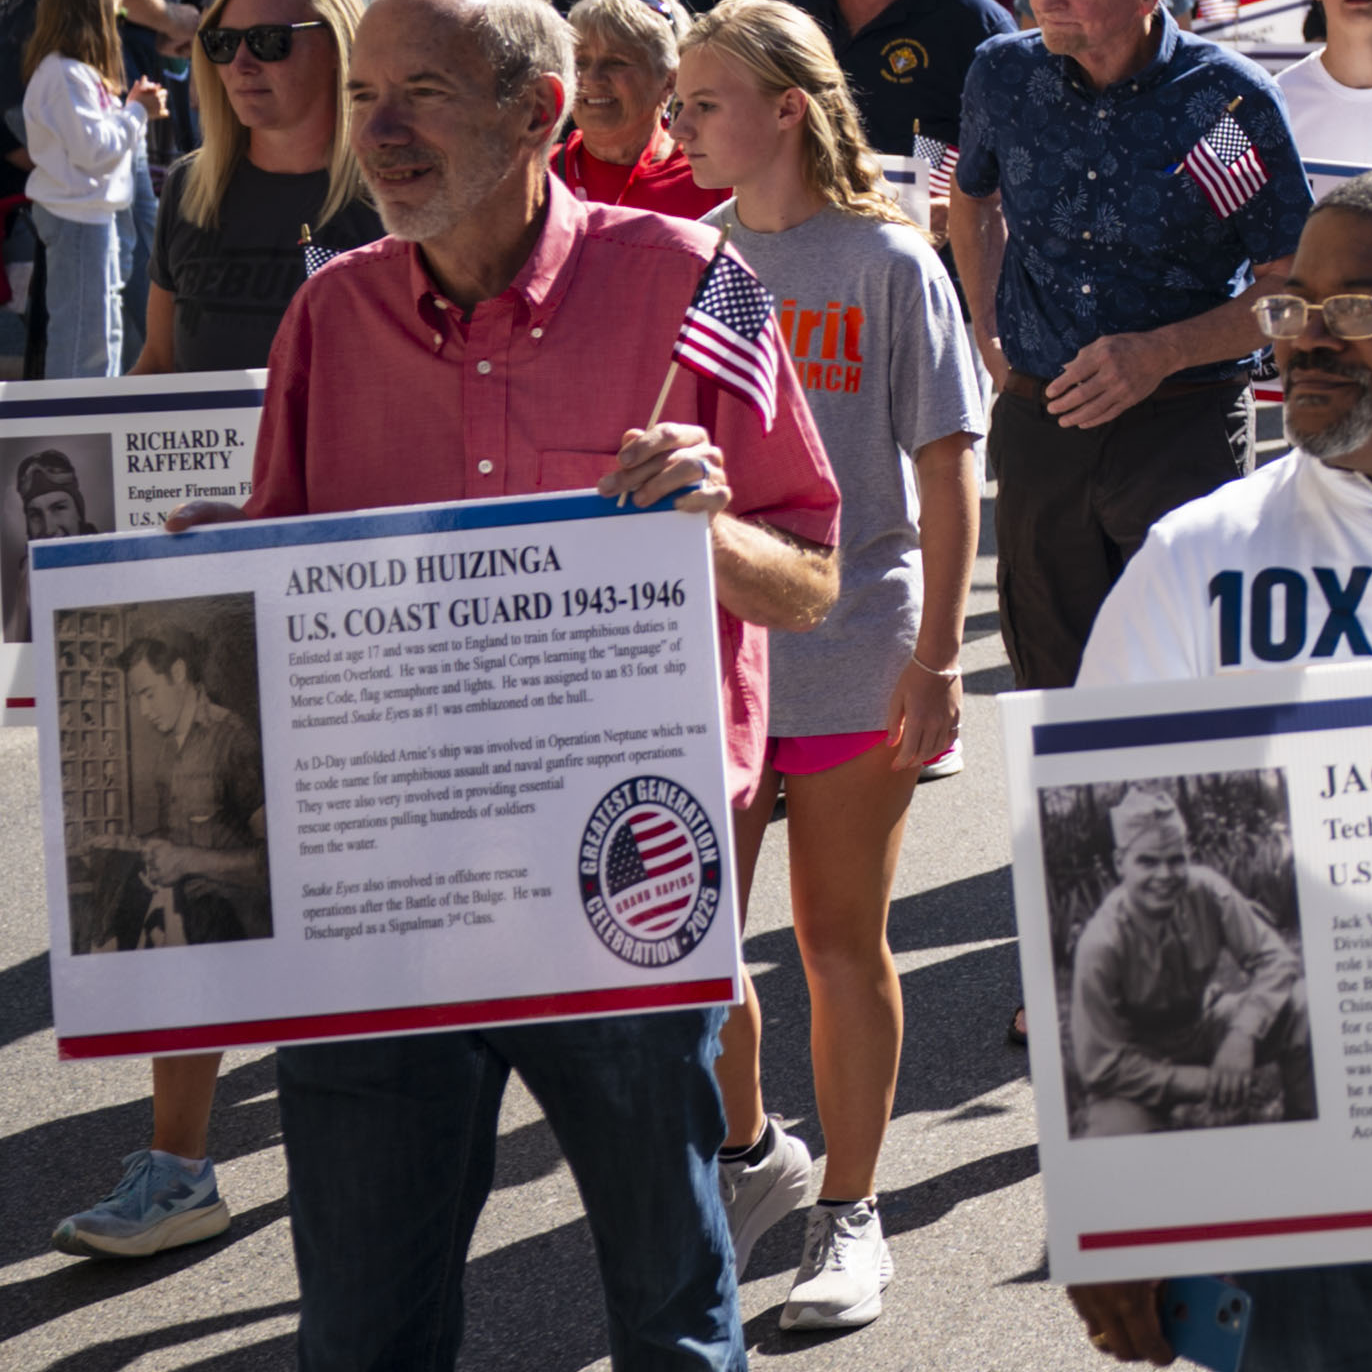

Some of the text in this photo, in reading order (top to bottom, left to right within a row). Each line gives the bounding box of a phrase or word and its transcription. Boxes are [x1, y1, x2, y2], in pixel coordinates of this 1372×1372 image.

[780, 299, 865, 364] irit
[126, 429, 244, 452] RICHARD R.
[127, 449, 232, 474] RAFFERTY
[128, 486, 182, 502] Engineer
[185, 484, 236, 500] Fireman
[130, 512, 155, 527] U.S.
[287, 546, 561, 596] ARNOLD HUIZINGA
[288, 579, 685, 642] U.S. COAST GUARD 1943-1946
[581, 779, 718, 875] GREATEST GENERATION
[615, 872, 695, 915] GRAND RAPIDS
[586, 886, 718, 965] CELEBRATION 2025
